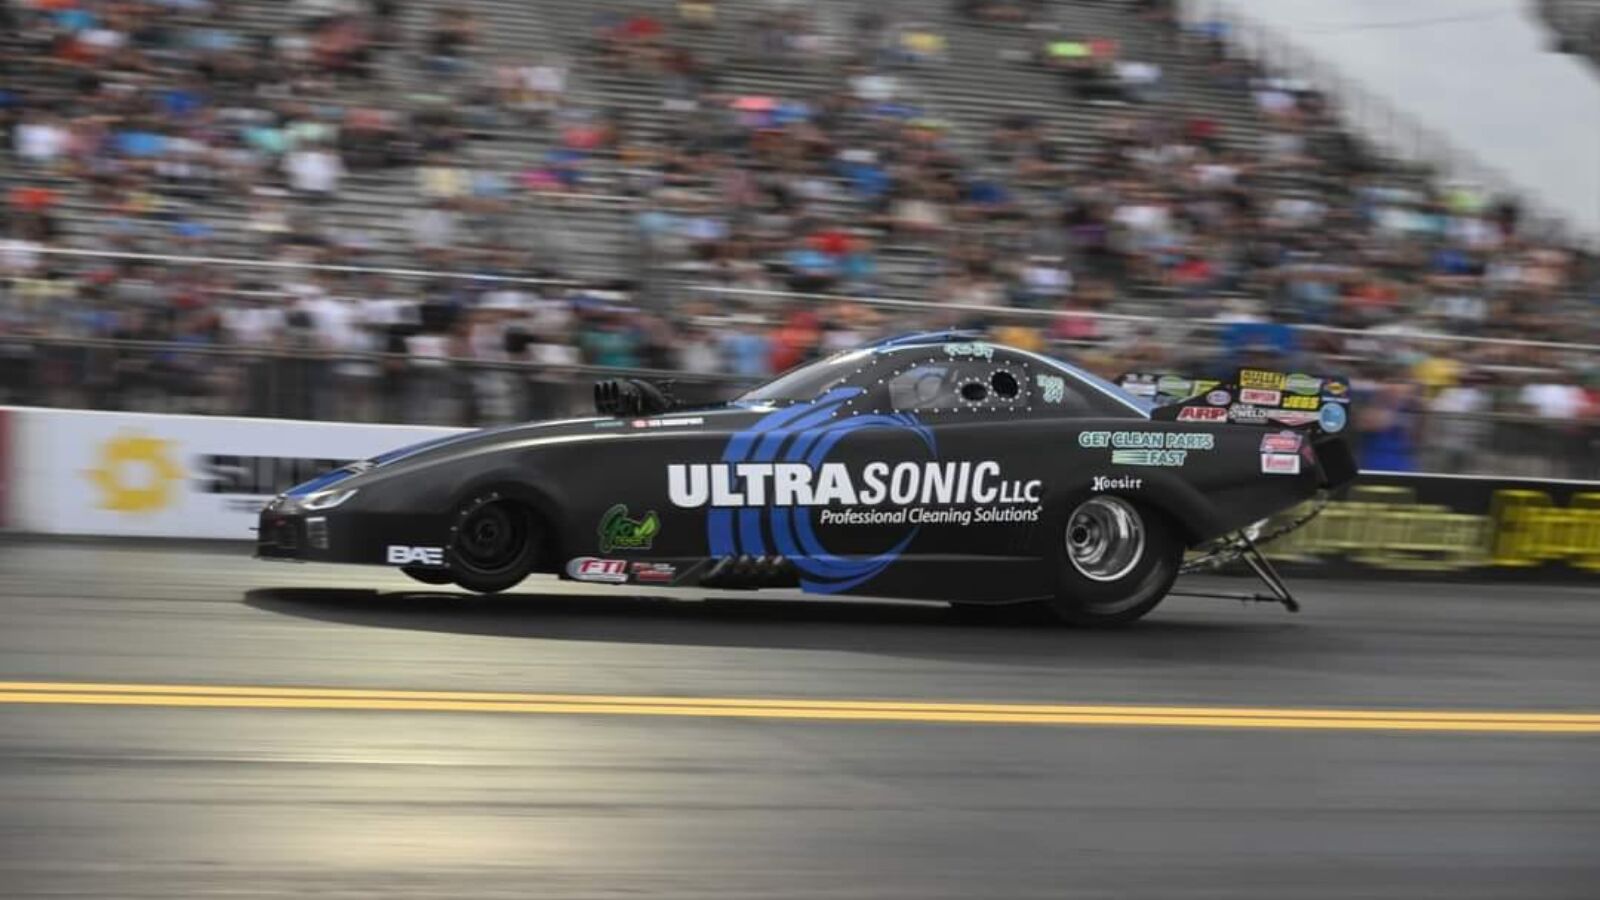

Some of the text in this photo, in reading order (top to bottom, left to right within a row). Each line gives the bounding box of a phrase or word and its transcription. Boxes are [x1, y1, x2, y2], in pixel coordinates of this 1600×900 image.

[1180, 406, 1224, 420] ARP
[1078, 431, 1214, 449] GET CLEAN PARTS
[1149, 450, 1187, 466] FAST
[668, 461, 1042, 507] ULTRASONIC LLC
[820, 508, 906, 525] Professional
[908, 508, 970, 526] Cleaning
[387, 545, 444, 564] BAE
